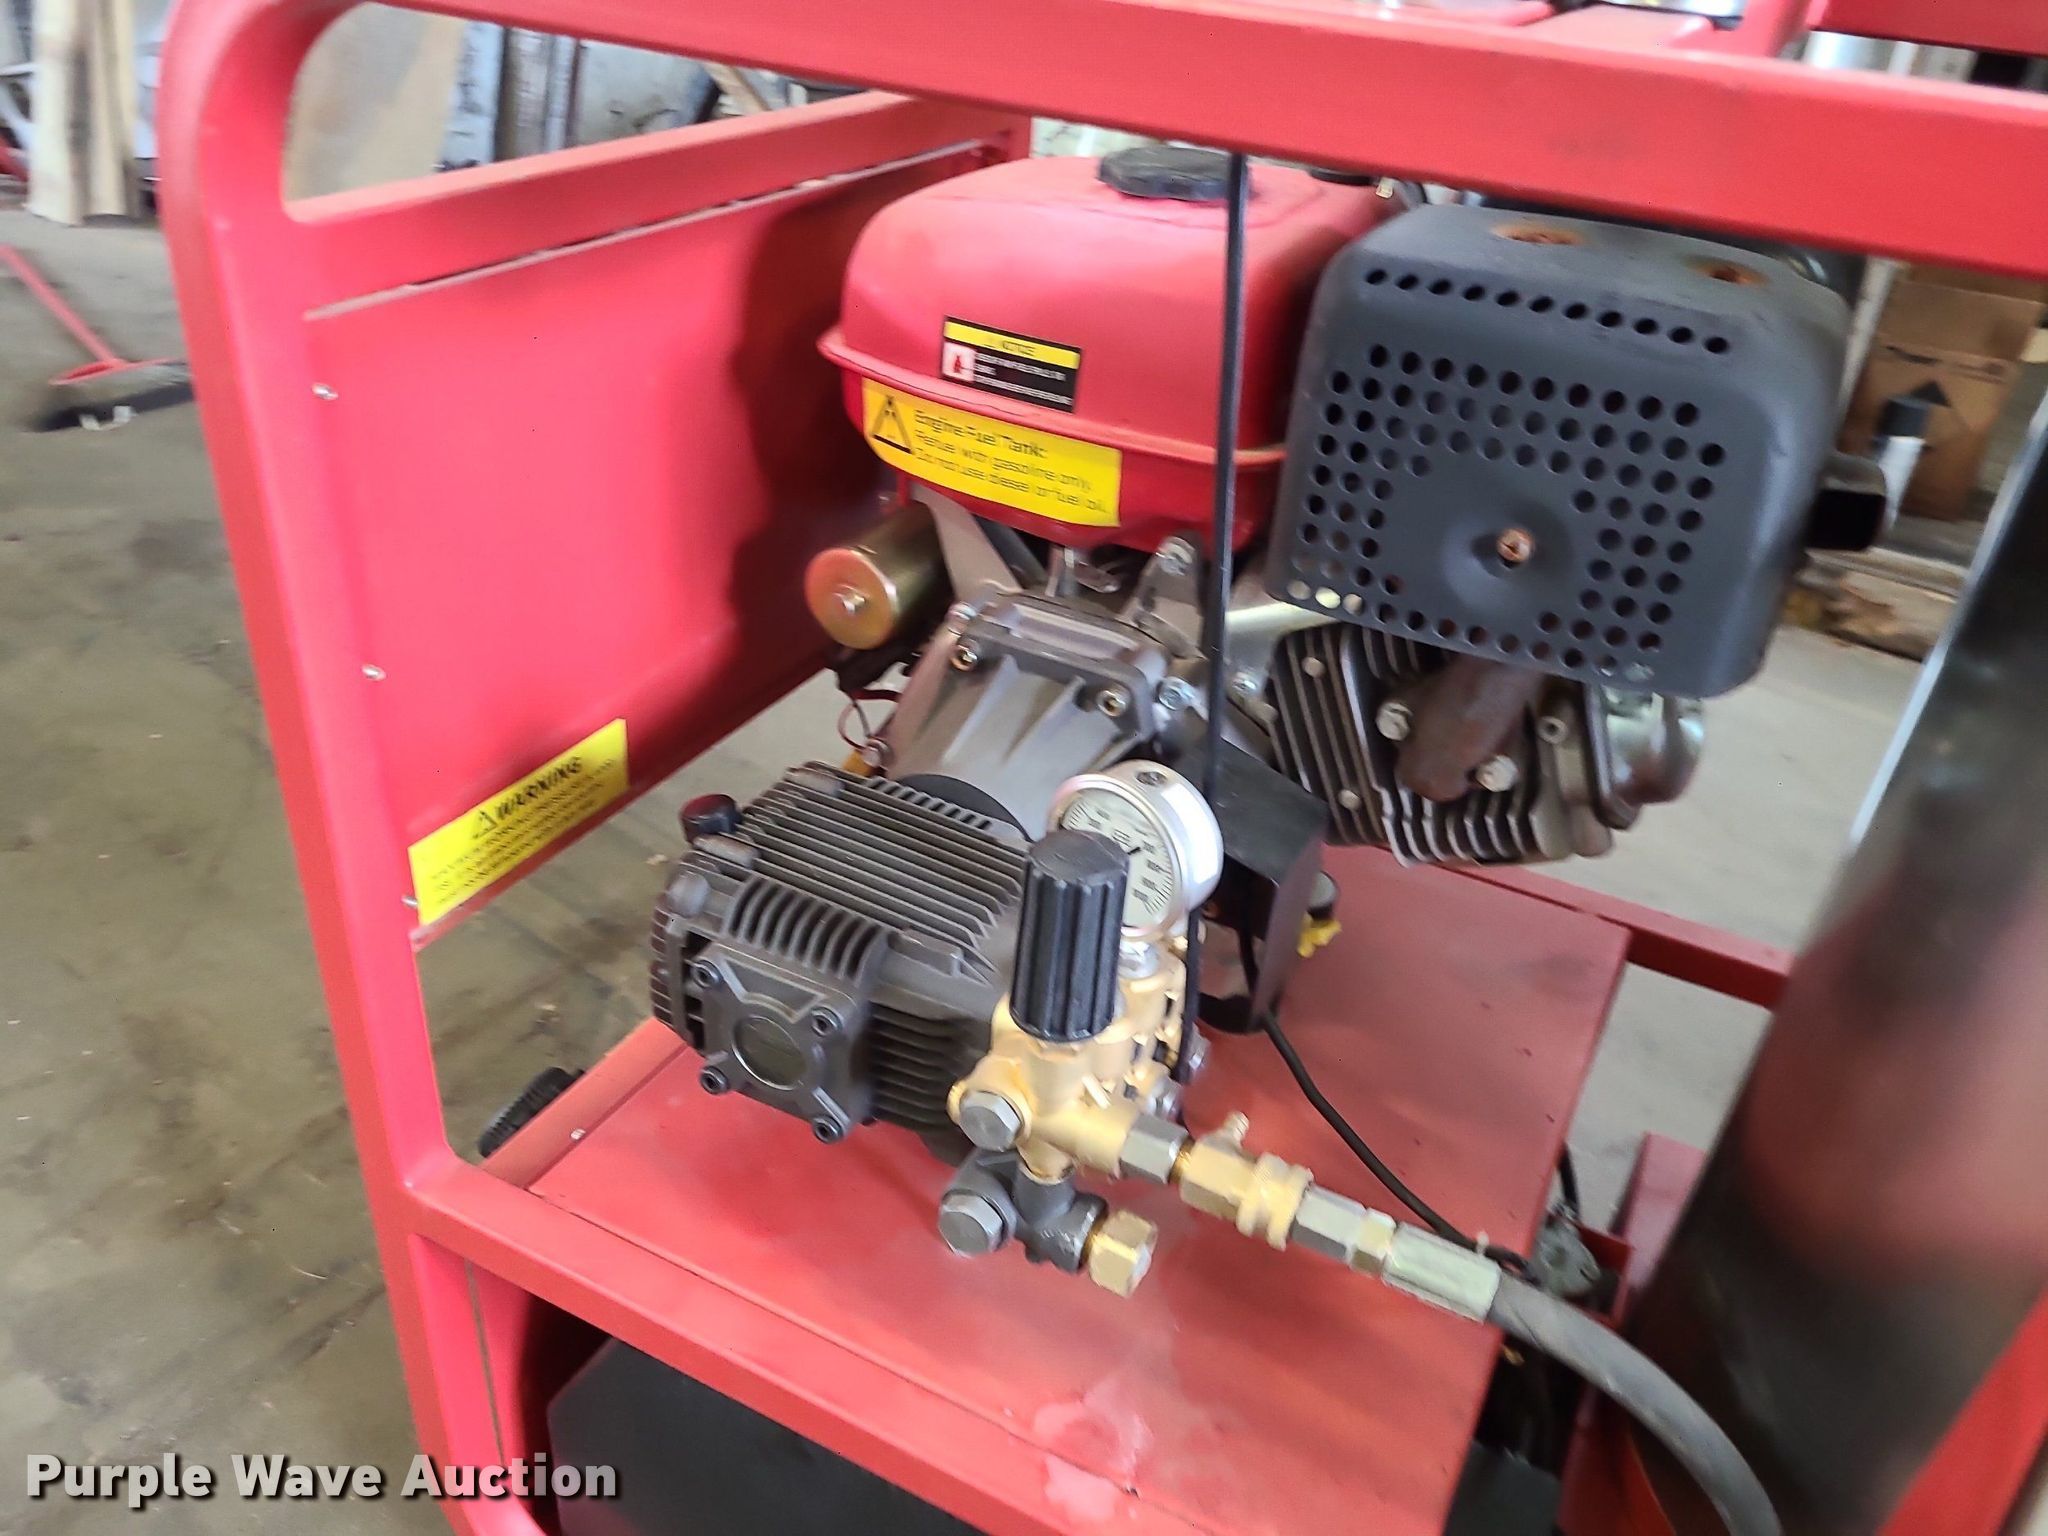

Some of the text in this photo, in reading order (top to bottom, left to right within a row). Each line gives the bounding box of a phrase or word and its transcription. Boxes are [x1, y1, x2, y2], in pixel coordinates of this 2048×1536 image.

[915, 409, 965, 437] Engine
[966, 425, 998, 447] Fuel
[989, 456, 1056, 481] gasoline
